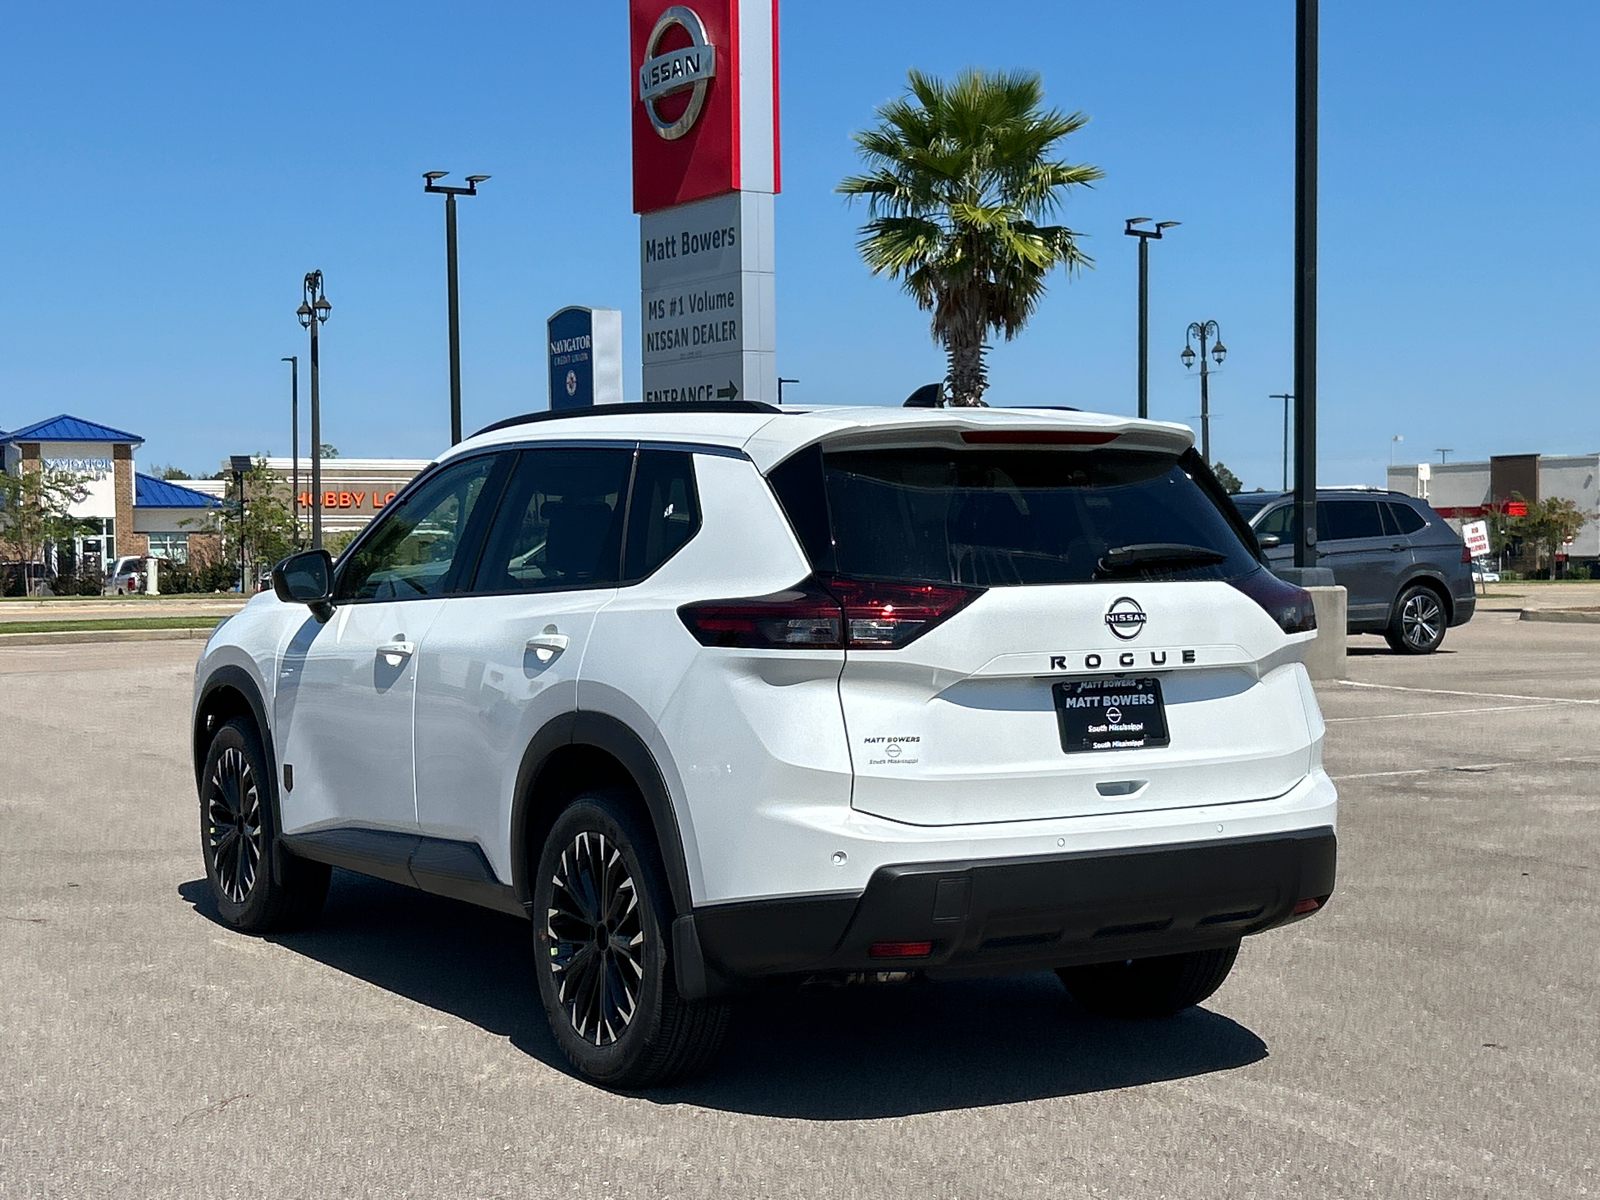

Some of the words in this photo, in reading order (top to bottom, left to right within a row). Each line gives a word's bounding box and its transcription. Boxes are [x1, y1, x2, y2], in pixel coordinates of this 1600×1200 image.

[642, 53, 700, 90] NISSAN
[646, 235, 677, 263] Matt
[681, 226, 735, 256] Bowers
[648, 299, 665, 321] MS
[669, 295, 684, 317] #1
[688, 290, 735, 314] Volume
[647, 327, 689, 352] NISSAN
[692, 320, 737, 346] DEALER
[550, 334, 591, 356] NAVIGATOR
[42, 458, 112, 469] NAVIGATOR
[1106, 614, 1147, 623] NISSAN
[1050, 649, 1196, 670] ROGUE
[1080, 681, 1102, 689] MATT
[1103, 680, 1136, 688] BOWERS
[1066, 697, 1100, 708] MATT
[1103, 694, 1154, 706] BOWERS
[1088, 725, 1107, 733] South
[1108, 722, 1143, 731] Mississippi
[1093, 741, 1111, 749] South
